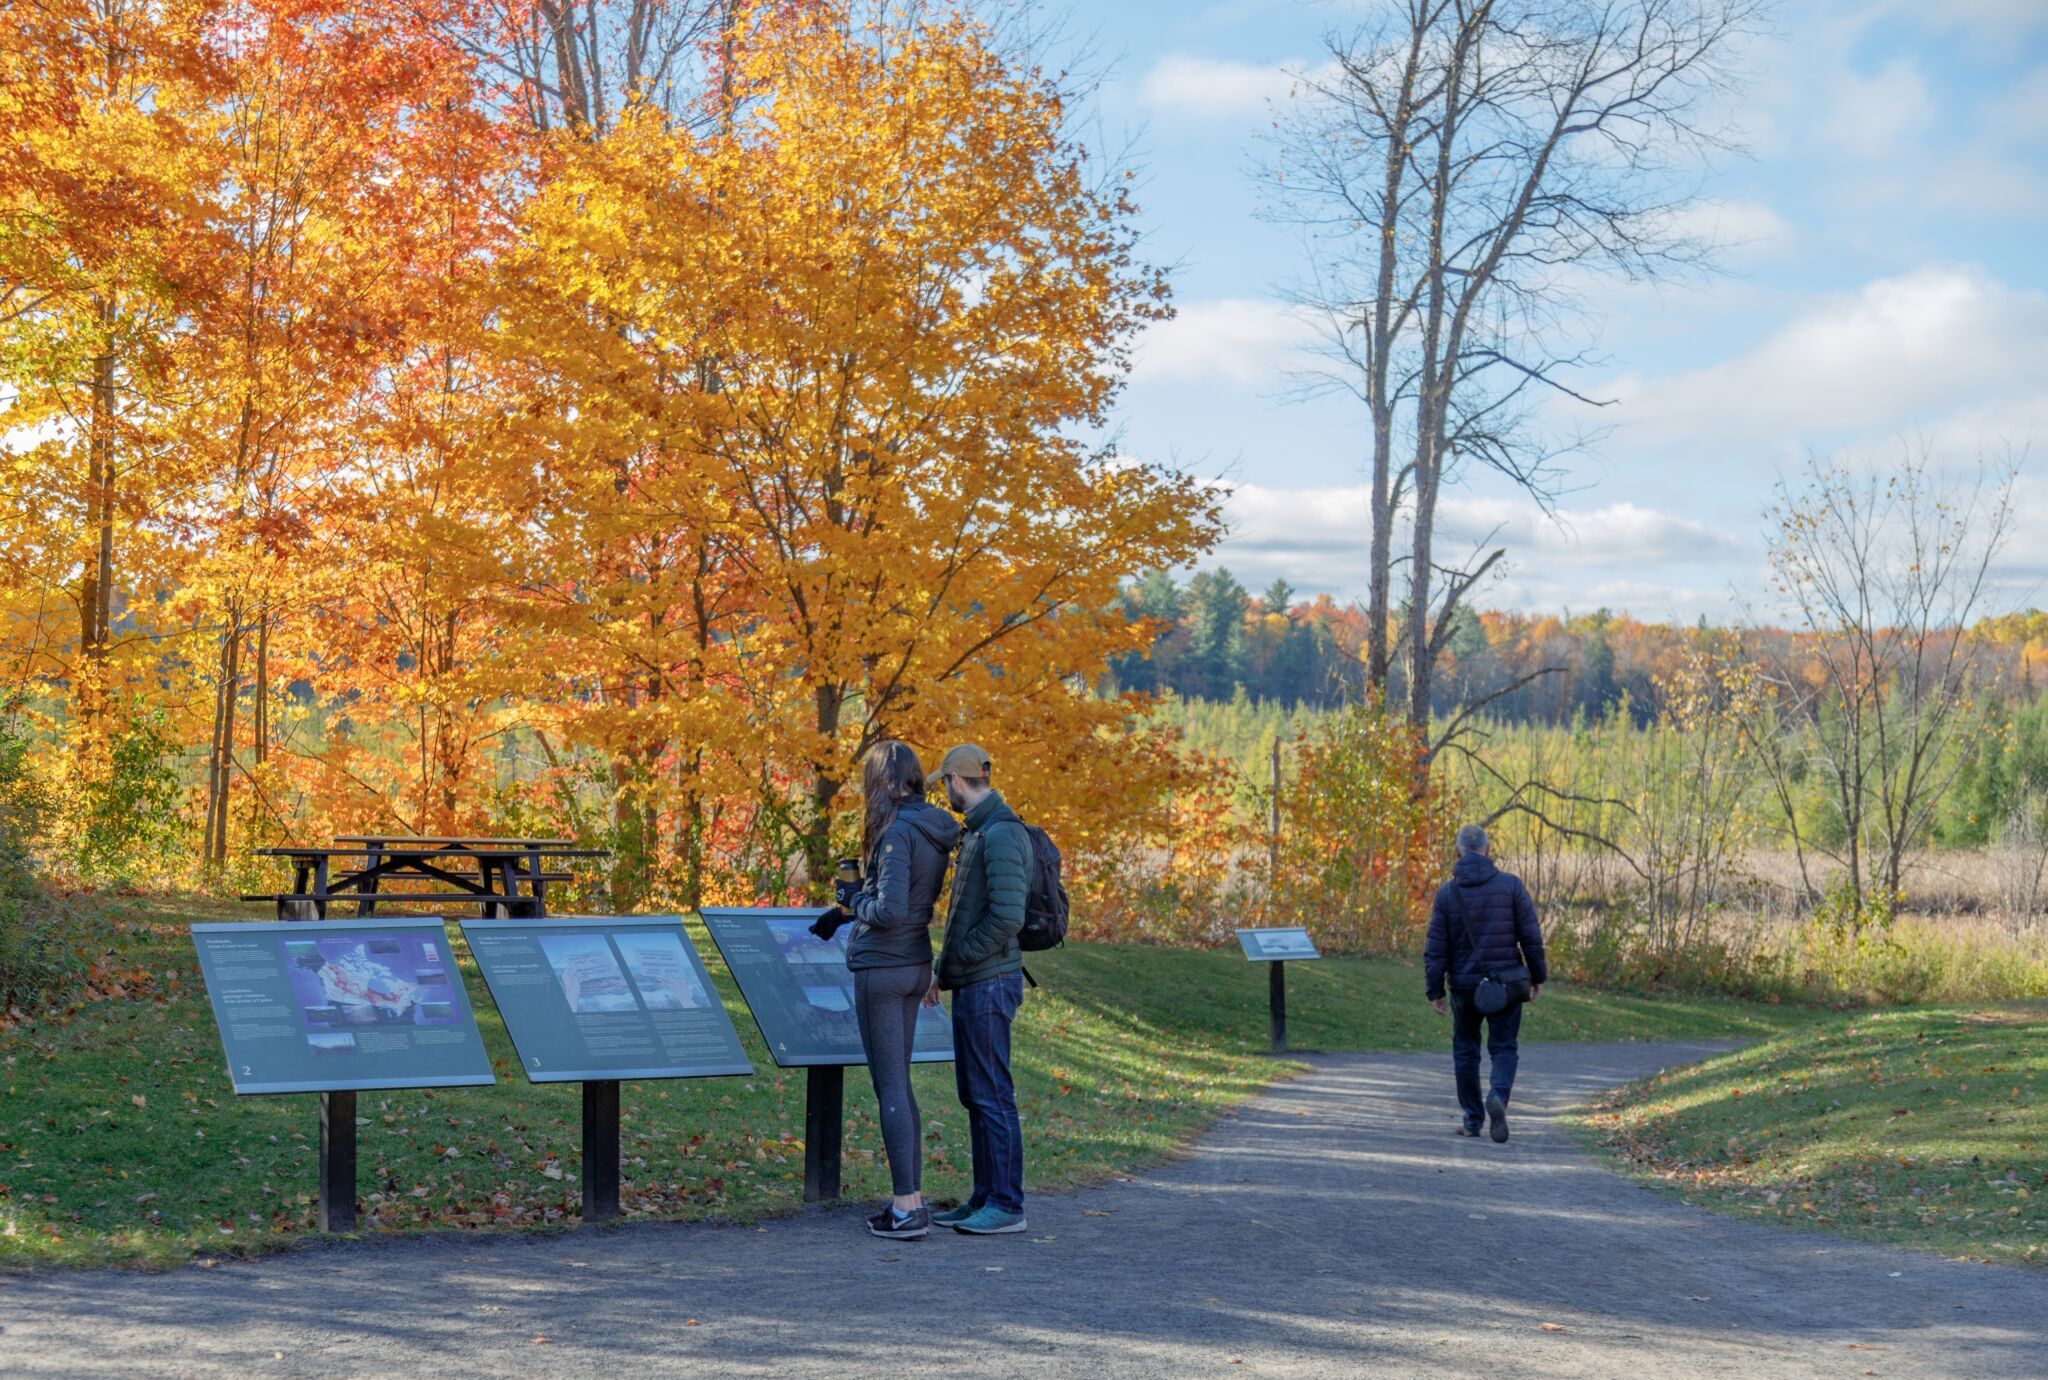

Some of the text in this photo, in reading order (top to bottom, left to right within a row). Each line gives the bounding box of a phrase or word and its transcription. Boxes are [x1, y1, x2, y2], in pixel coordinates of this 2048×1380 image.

[779, 1042, 787, 1052] 4
[532, 1057, 541, 1068] 3
[242, 1065, 252, 1076] 2
